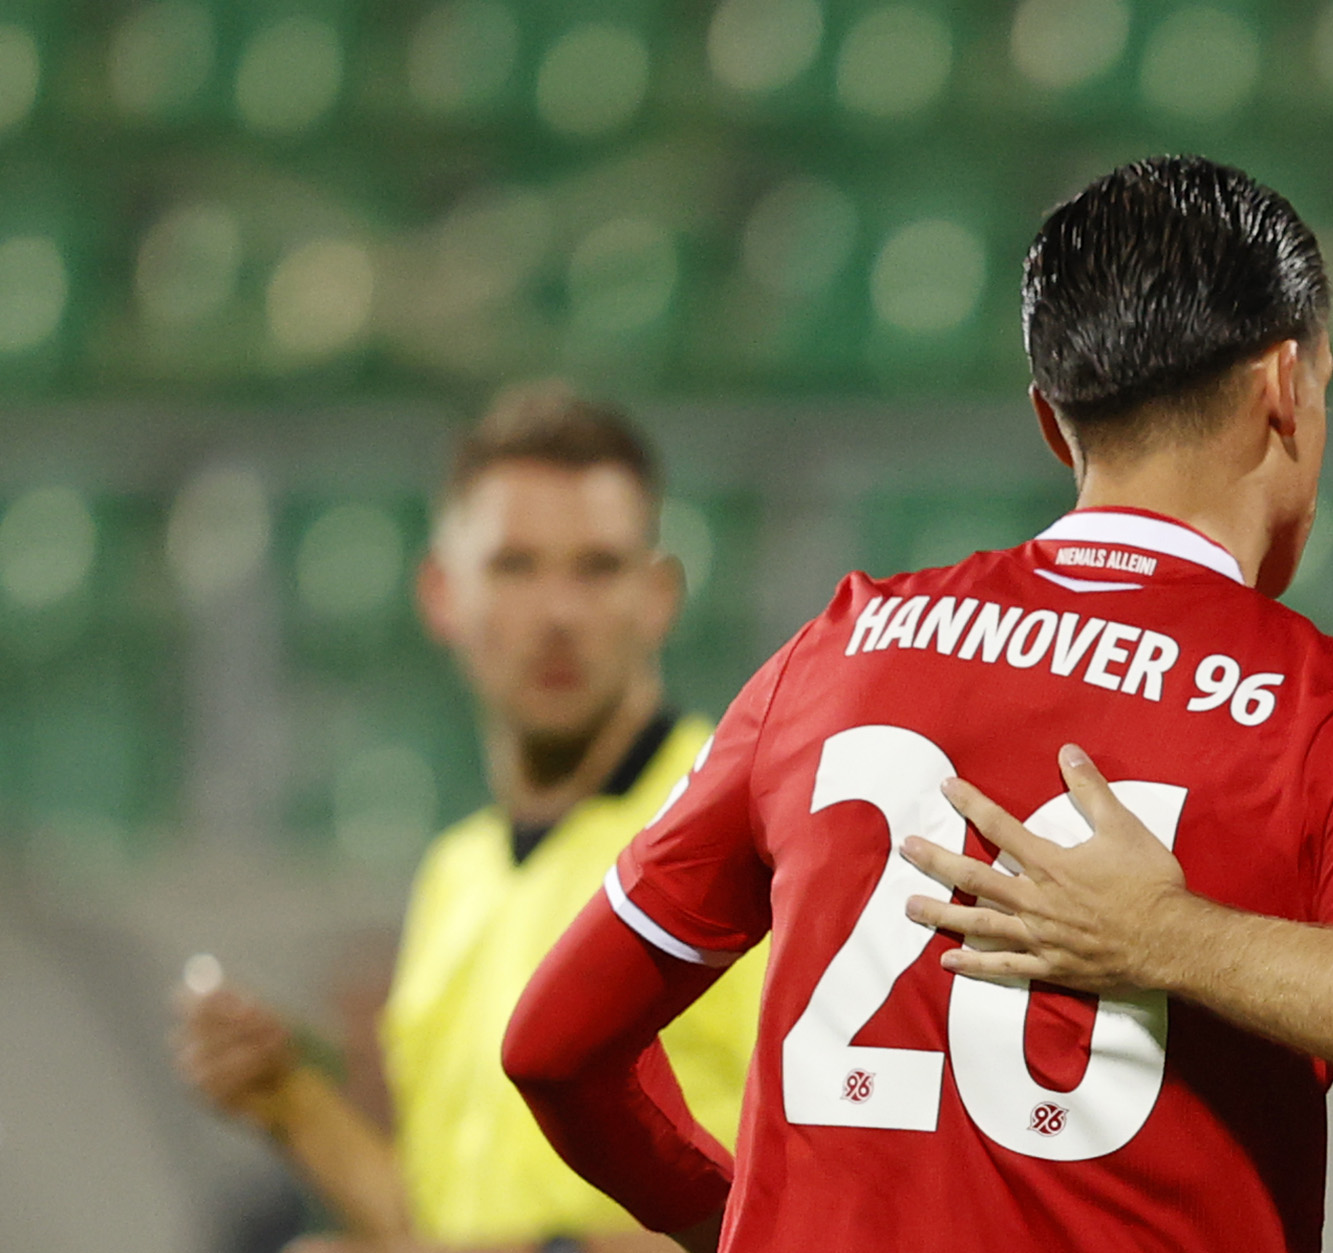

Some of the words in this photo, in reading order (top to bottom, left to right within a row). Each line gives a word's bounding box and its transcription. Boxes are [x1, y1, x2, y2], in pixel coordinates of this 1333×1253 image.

[1106, 549, 1158, 576] ALLEIN!
[845, 595, 1180, 702] HANNOVER
[1186, 654, 1285, 727] 96
